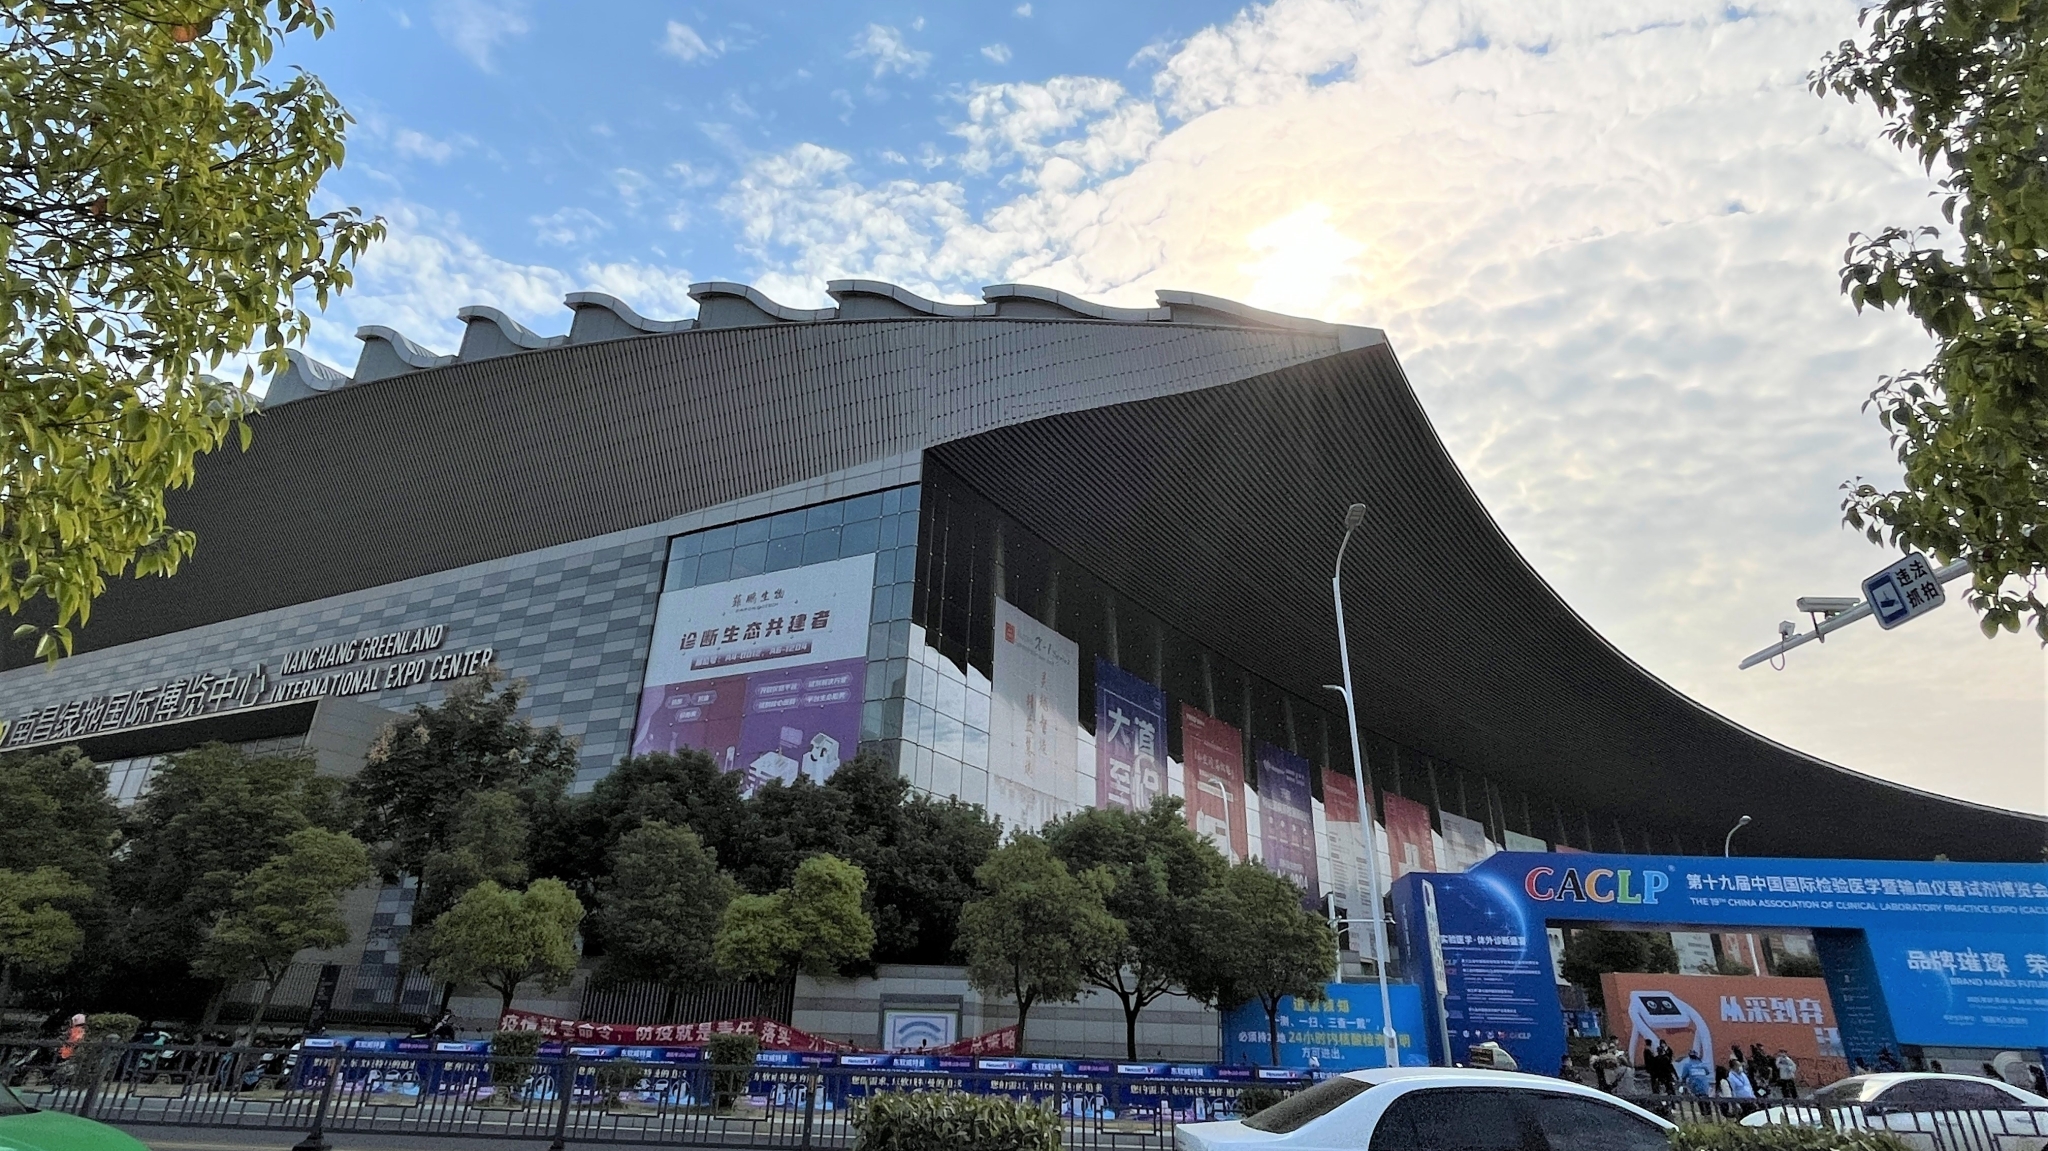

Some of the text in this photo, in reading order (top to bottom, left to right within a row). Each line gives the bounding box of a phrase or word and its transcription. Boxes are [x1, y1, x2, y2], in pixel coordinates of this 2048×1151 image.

[1895, 560, 1928, 587] 违法
[1906, 581, 1940, 609] 抓拍
[679, 610, 831, 650] 诊断生态共建者
[280, 624, 445, 676] NANCHANG GREENLAND
[269, 648, 494, 703] INTERNATIONAL EXPO CENTER
[7, 663, 266, 747] 南昌绿地国际博览中心
[1108, 707, 1156, 760] 大道
[1524, 866, 1669, 905] CACLP
[1686, 873, 2048, 898] 第十九届中国国际检验医学暨输血仪器试剂博览会
[1690, 897, 1709, 906] THE
[1728, 898, 1757, 907] CHINA
[1758, 899, 1820, 910] ASSOCIATION
[1821, 901, 1834, 910] OF
[1836, 901, 1879, 911] CLINICAL
[1880, 902, 1944, 912] LABORATORY
[1944, 903, 1991, 914] PRACTICE
[1991, 905, 2017, 914] EXPO
[1907, 947, 2048, 979] 品牌璀璨 荣
[1950, 977, 1983, 987] BRAND
[1984, 978, 2017, 988] MAKES
[1720, 996, 1824, 1025] 从采到弃
[636, 1021, 754, 1042] 防疫就是责任
[760, 1022, 792, 1046] 落实
[1288, 1031, 1411, 1048] 24小时内核酸检测明
